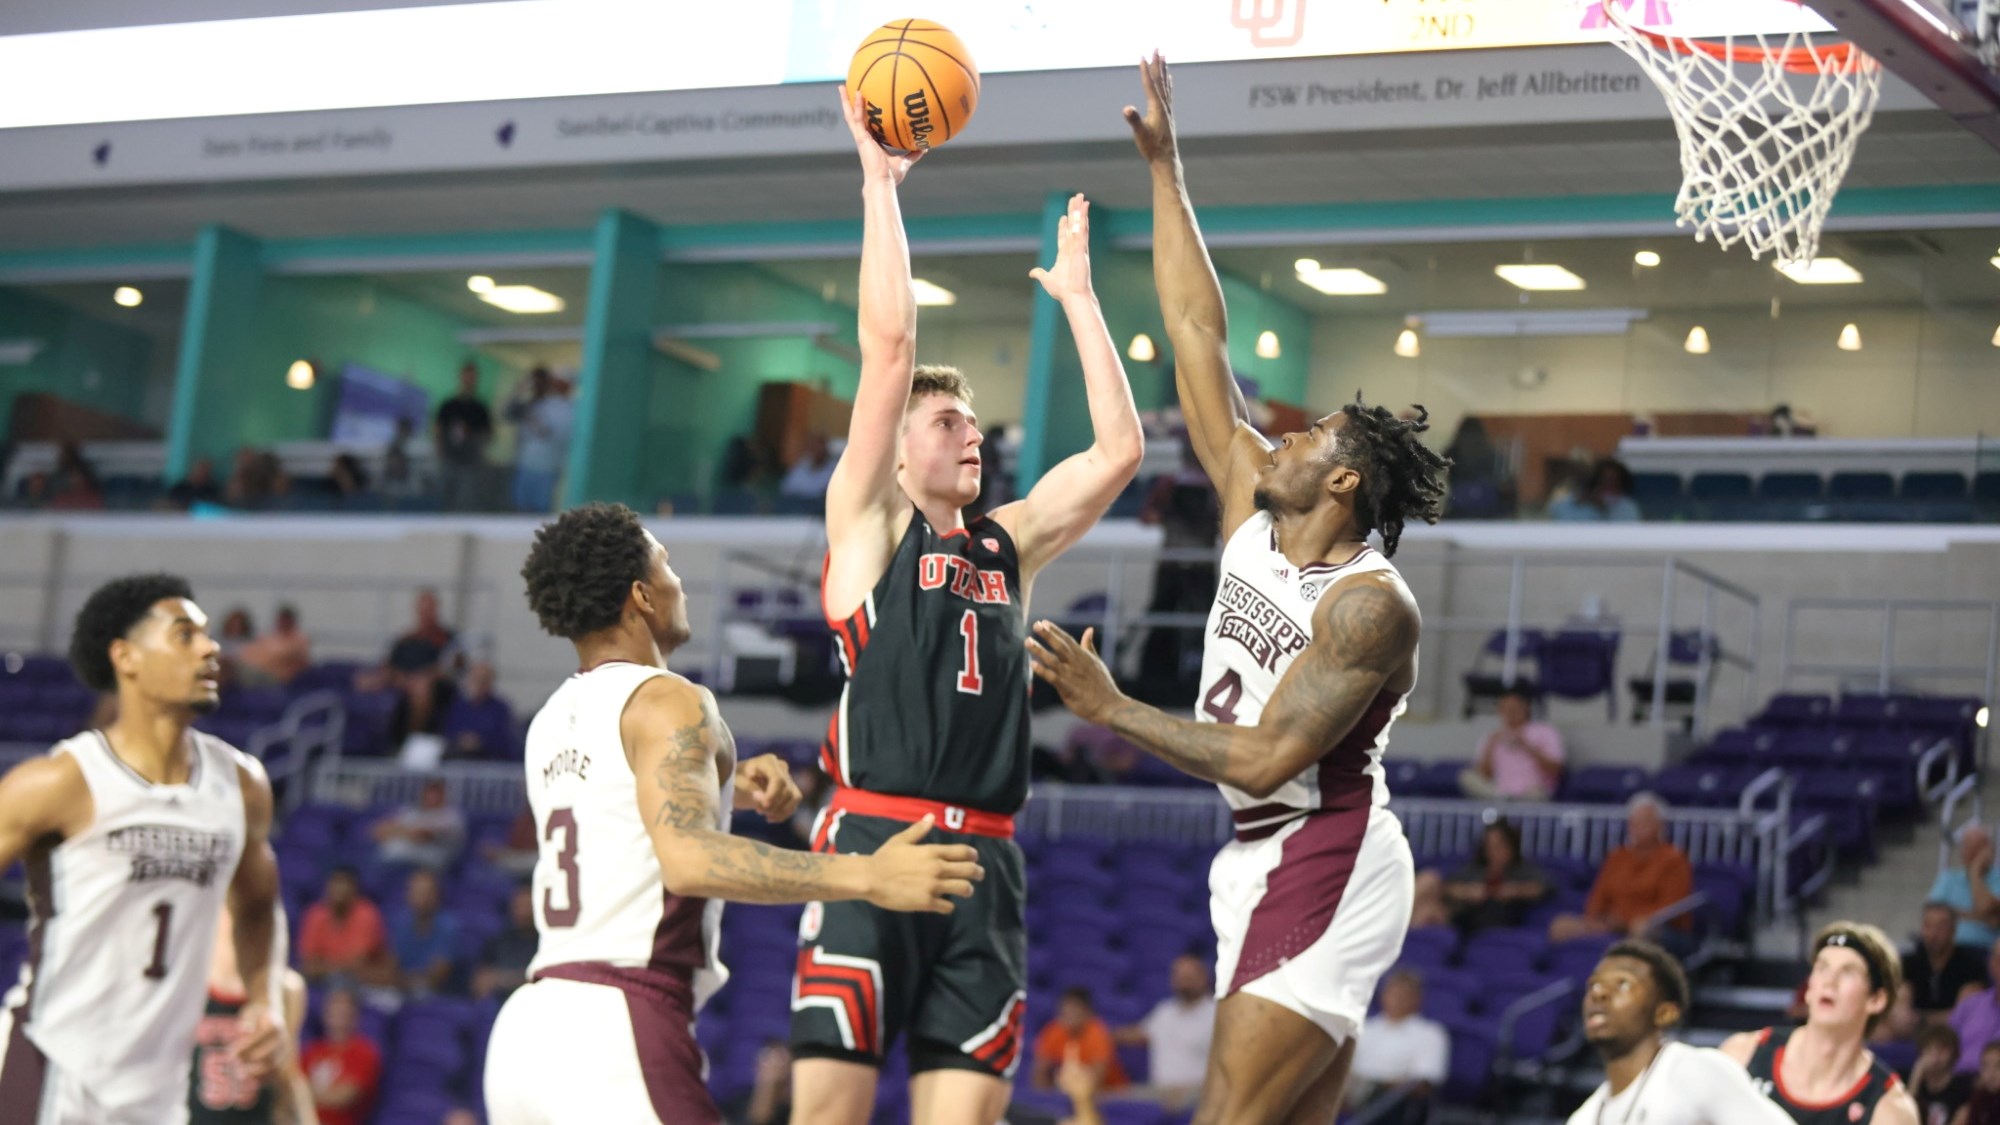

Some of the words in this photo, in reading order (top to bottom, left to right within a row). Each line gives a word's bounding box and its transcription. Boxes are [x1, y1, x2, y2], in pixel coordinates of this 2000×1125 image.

[1249, 83, 1300, 108] FSW
[1476, 72, 1518, 101] Jeff
[1523, 70, 1641, 97] Allbritten
[719, 107, 839, 131] Community
[903, 88, 935, 150] Wilso
[919, 553, 1011, 606] UTAH
[1218, 576, 1313, 656] MISSISSIPP
[1222, 616, 1267, 661] STATE
[956, 608, 983, 696] 1
[1203, 667, 1243, 724] 4
[543, 749, 591, 788] MOORE
[543, 806, 582, 929] 3
[143, 901, 174, 981] 1
